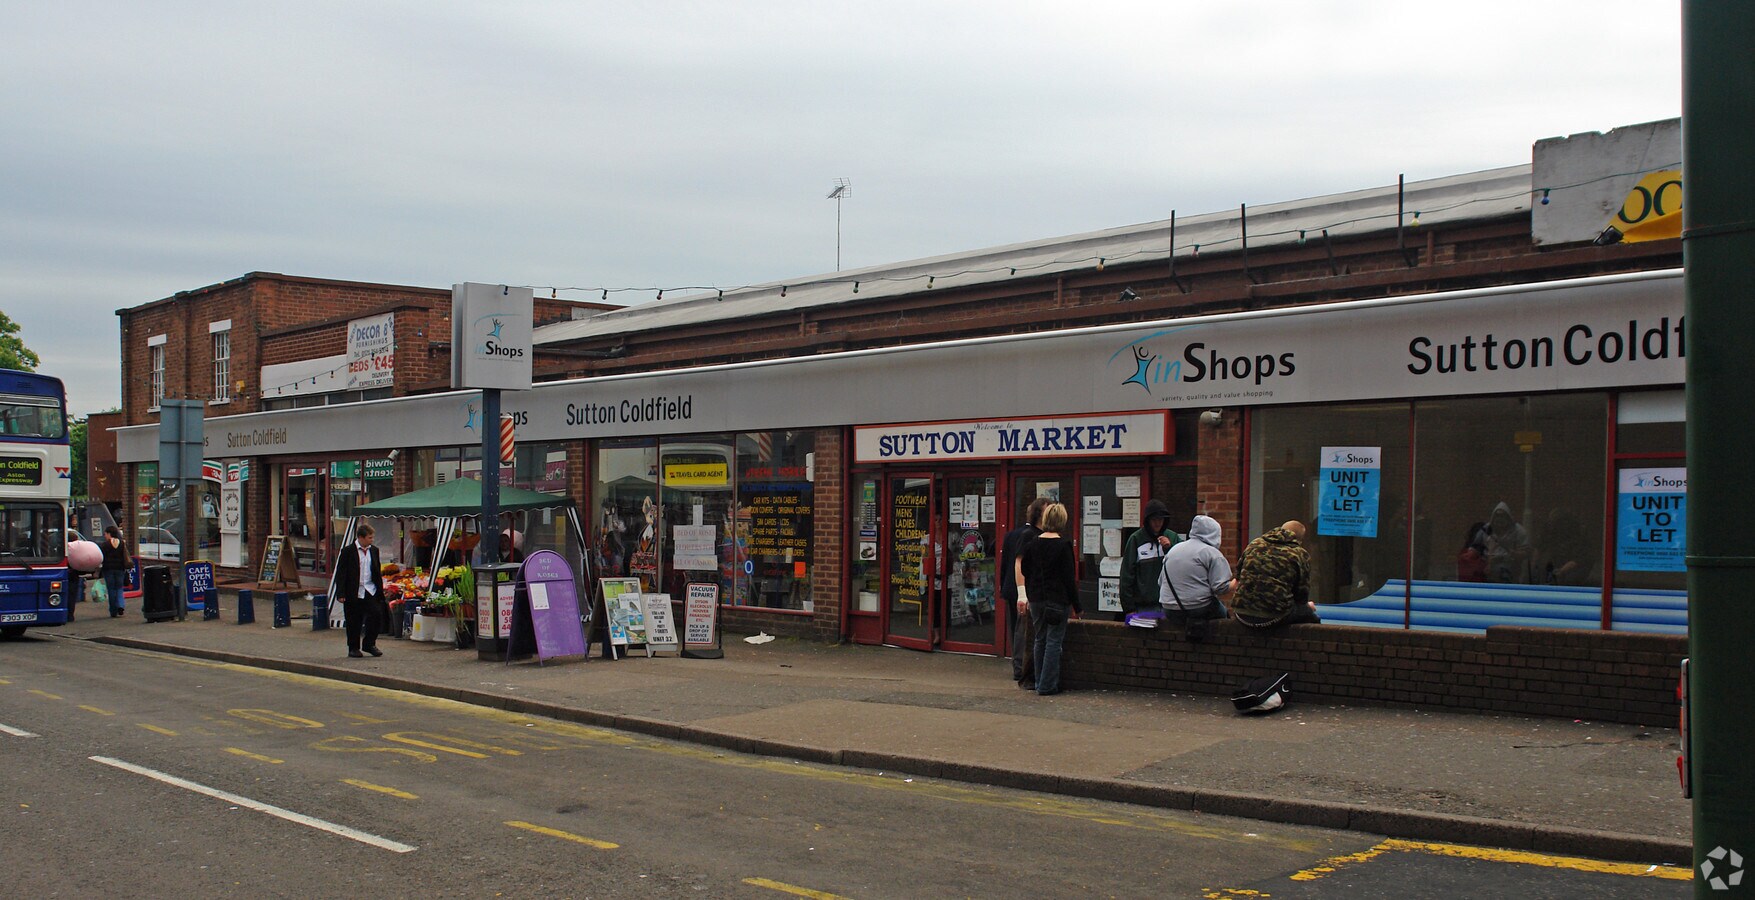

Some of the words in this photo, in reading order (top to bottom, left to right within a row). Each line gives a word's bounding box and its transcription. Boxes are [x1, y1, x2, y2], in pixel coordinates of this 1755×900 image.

[356, 325, 380, 341] DECOR
[1407, 334, 1553, 375] Sutton
[1186, 393, 1208, 401] quality
[1243, 390, 1274, 398] shopping
[567, 404, 616, 426] Sutton
[620, 395, 692, 423] Coldfield
[973, 423, 1004, 431] Welcome
[227, 432, 251, 448] Sutton
[252, 427, 287, 446] Coldfield
[879, 431, 976, 457] SUTTON
[998, 424, 1127, 452] MARKET
[8, 461, 39, 469] Coldfield
[1331, 471, 1369, 483] UNIT
[1337, 485, 1360, 497] TO
[895, 495, 928, 505] FOOTWEAR
[1334, 499, 1363, 512] LET
[1632, 496, 1683, 509] UNIT
[895, 508, 913, 518] MENS
[1641, 512, 1672, 526] TO
[895, 519, 915, 528] LADIES
[895, 529, 927, 540] CHILDRENS
[1637, 529, 1677, 542] LET
[189, 573, 211, 581] OPEN
[193, 585, 208, 593] DAY
